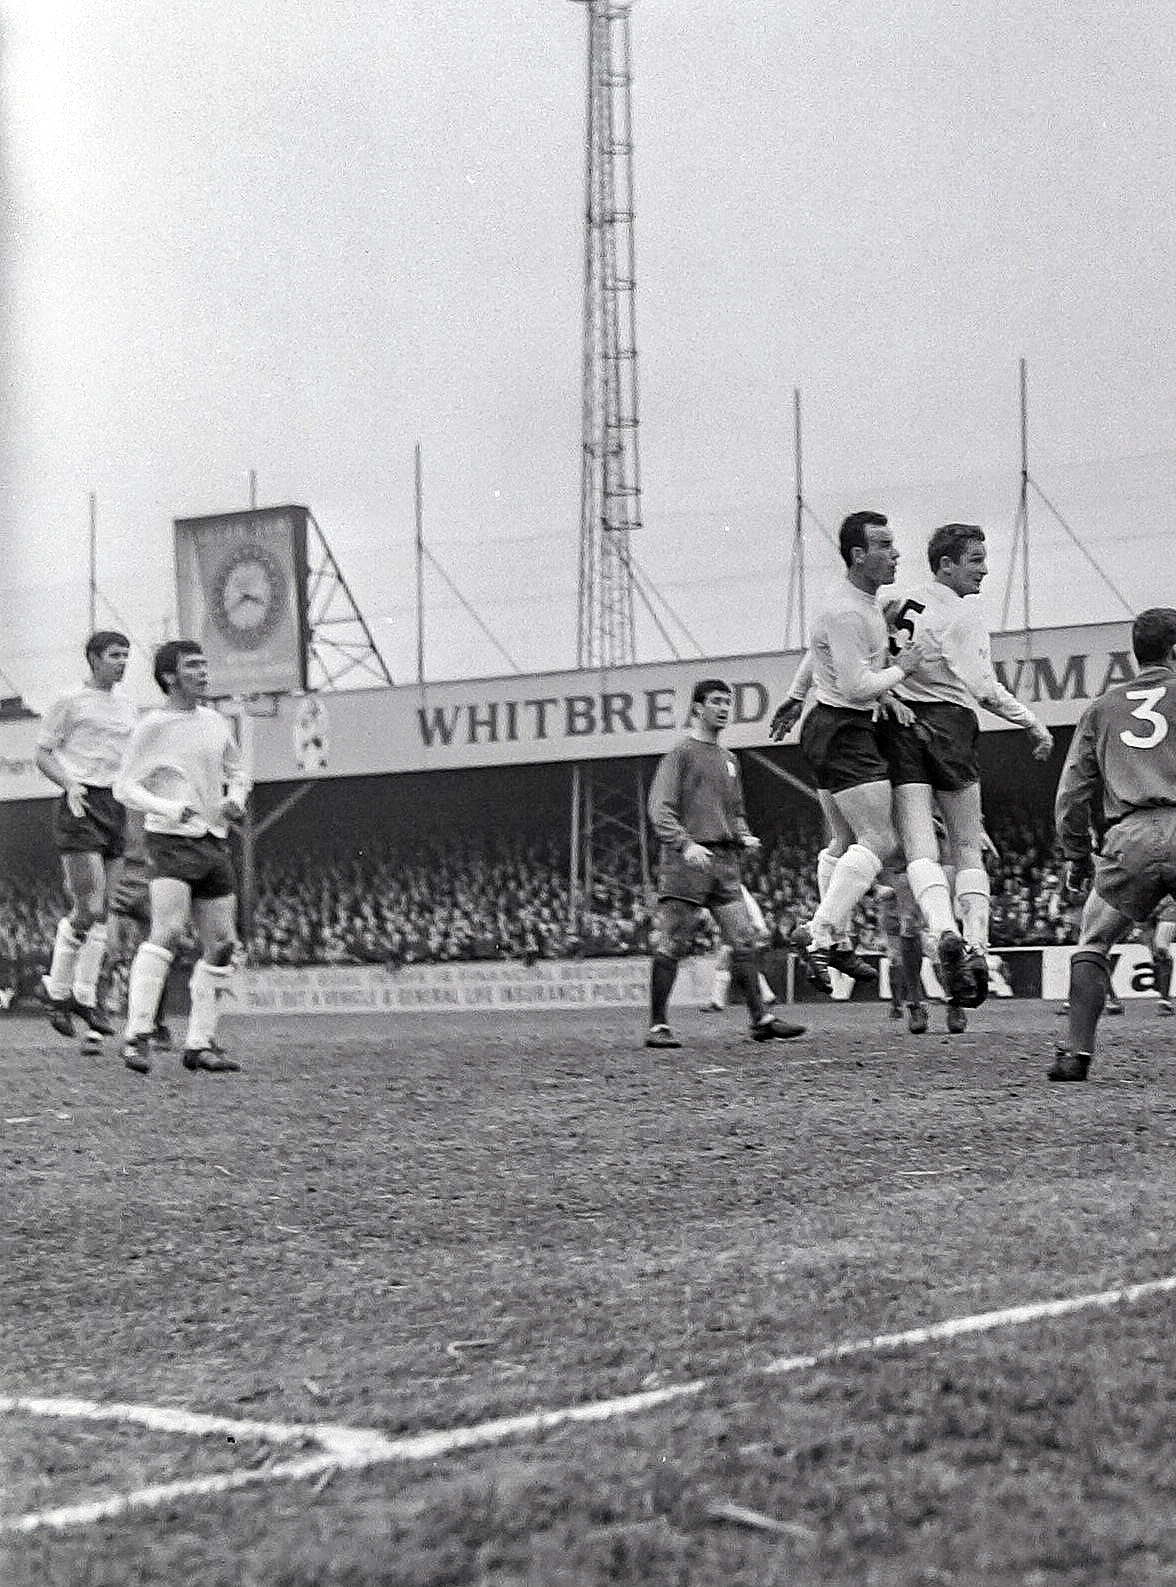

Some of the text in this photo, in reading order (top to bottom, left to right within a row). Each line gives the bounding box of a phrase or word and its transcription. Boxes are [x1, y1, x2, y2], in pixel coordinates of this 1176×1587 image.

[888, 599, 926, 657] 5
[416, 681, 770, 747] WHITBRED
[1119, 686, 1168, 749] 3
